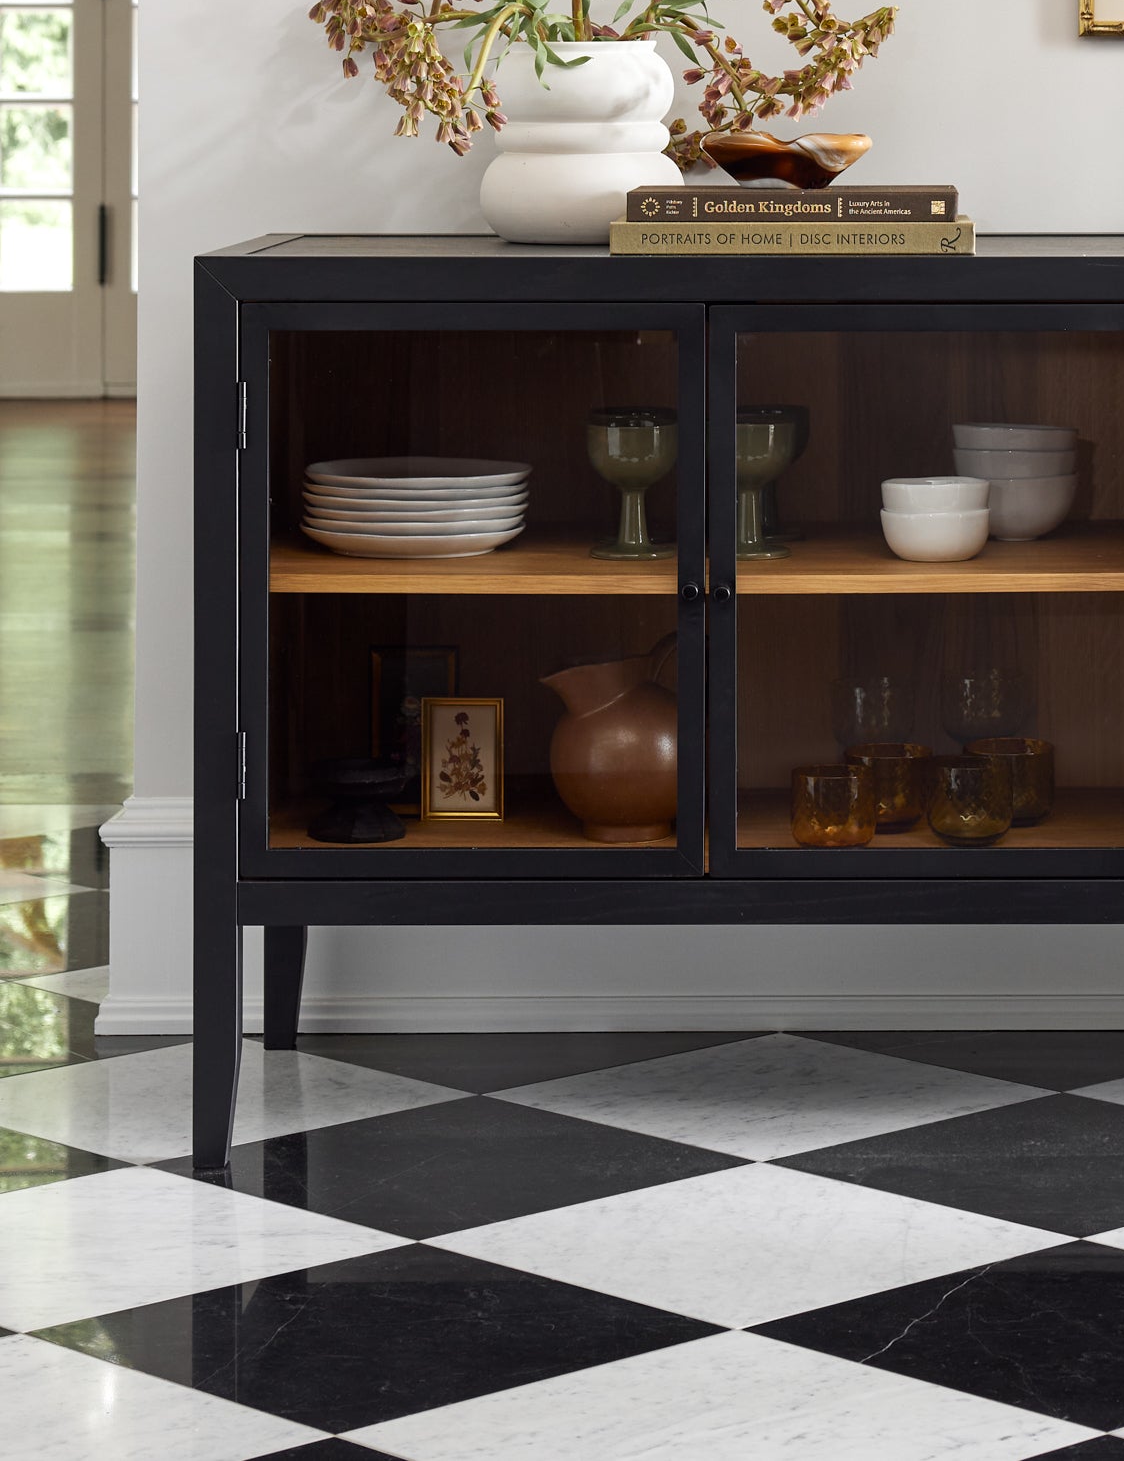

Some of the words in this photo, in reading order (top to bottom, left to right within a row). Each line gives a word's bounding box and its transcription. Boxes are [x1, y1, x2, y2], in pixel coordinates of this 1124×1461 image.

[704, 200, 755, 213] Golden
[758, 200, 832, 217] Kingdoms
[849, 200, 870, 208] Luxury
[641, 233, 713, 246] PORTRAITS
[716, 233, 737, 246] OF
[741, 233, 782, 246] HOME
[800, 233, 831, 246] DISC
[836, 233, 906, 245] INTERIORS
